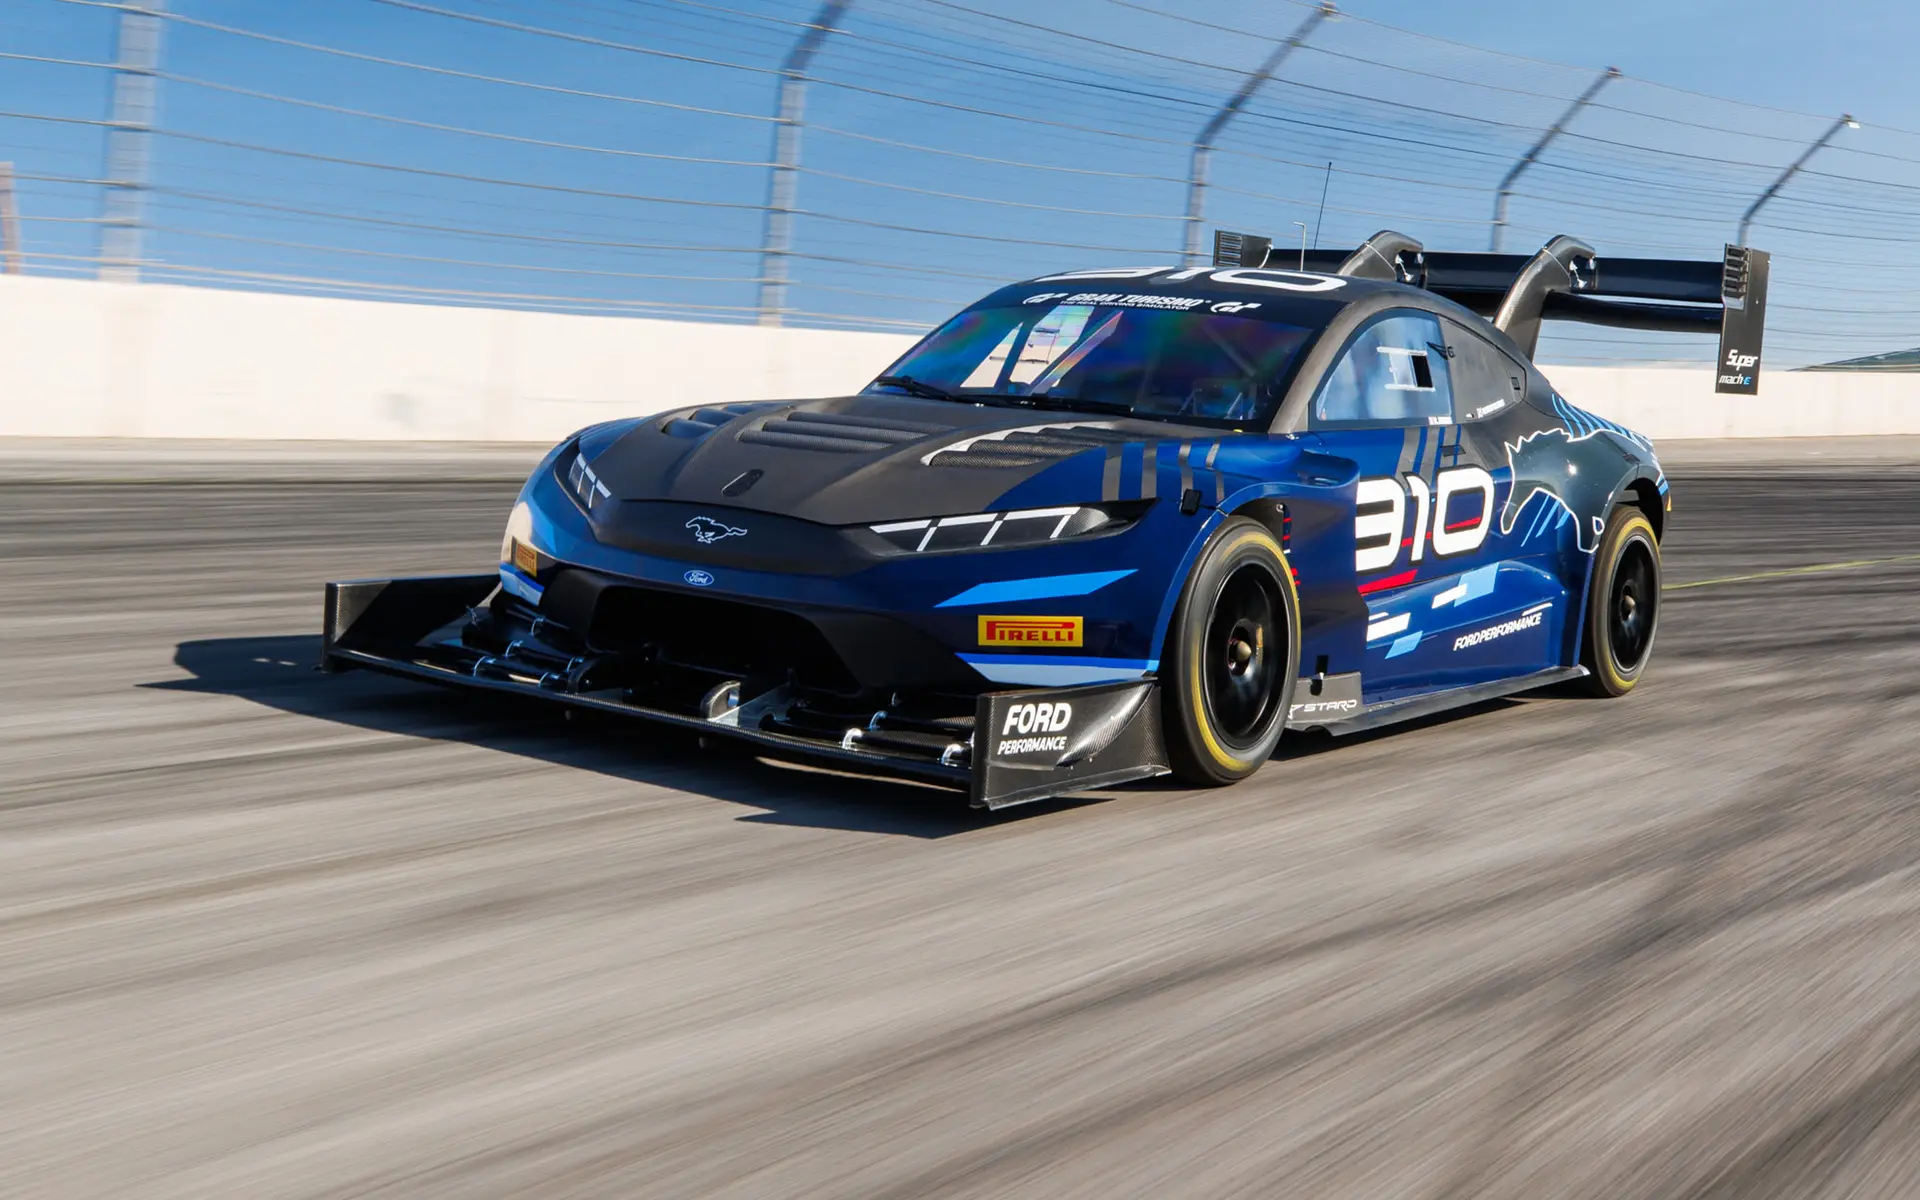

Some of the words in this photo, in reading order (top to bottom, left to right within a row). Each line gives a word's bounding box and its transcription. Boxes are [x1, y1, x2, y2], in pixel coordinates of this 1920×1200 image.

[1066, 293, 1124, 302] GRAN
[1726, 349, 1758, 371] Super
[1355, 467, 1495, 572] 310
[689, 572, 709, 584] Ford
[986, 621, 1075, 641] PIRELLI
[1303, 699, 1357, 712] STARD
[1002, 702, 1072, 735] FORD
[997, 736, 1067, 755] PERFORMANCE
